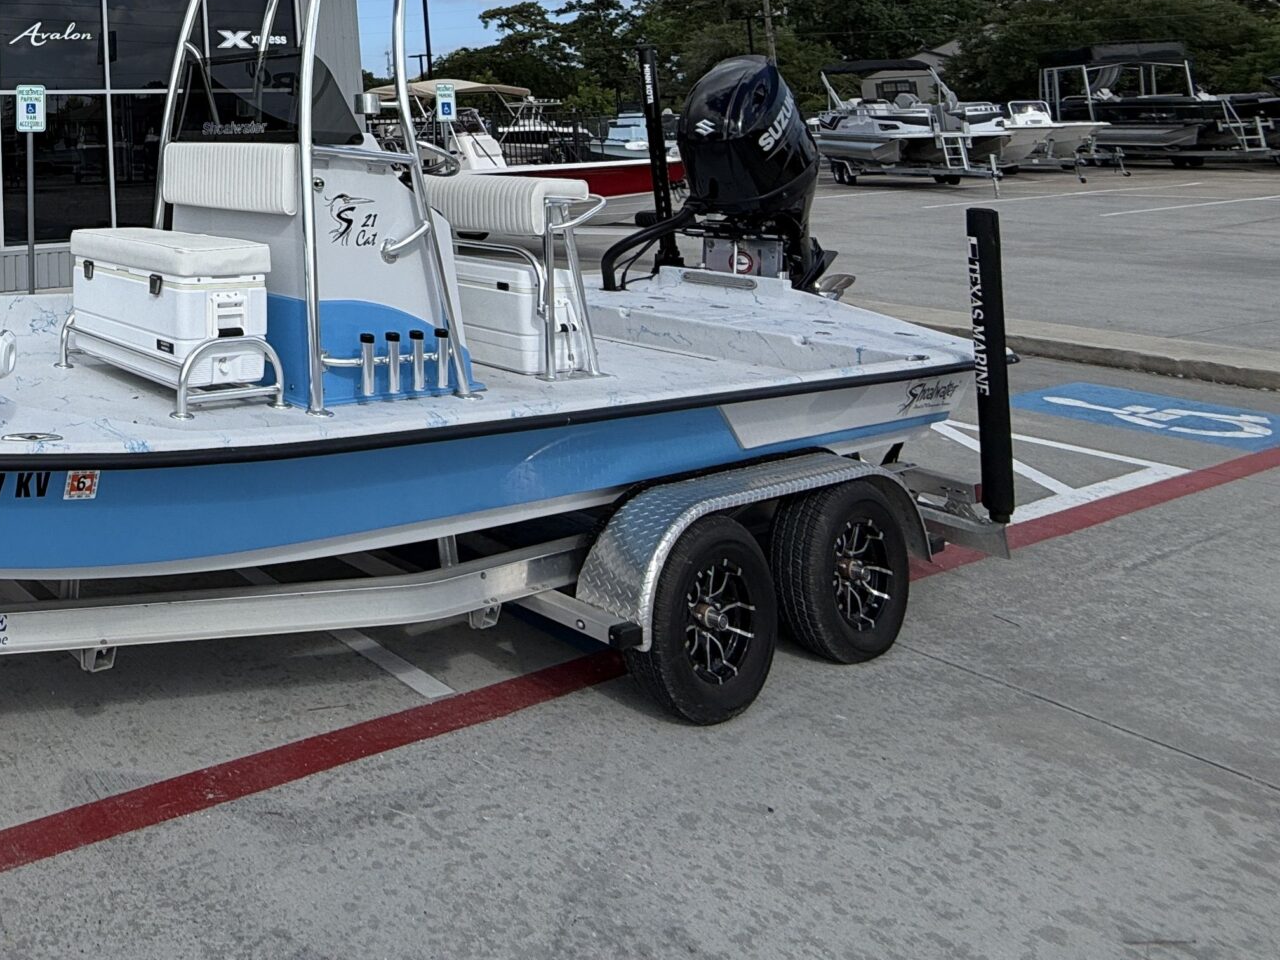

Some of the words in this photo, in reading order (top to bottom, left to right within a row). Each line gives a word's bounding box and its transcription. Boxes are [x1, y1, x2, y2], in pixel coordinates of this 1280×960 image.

[9, 21, 94, 47] Avalon
[251, 35, 288, 46] xess
[202, 121, 268, 135] Shoalwater
[361, 213, 378, 228] 21
[355, 229, 378, 247] Cat
[969, 259, 985, 321] TEXAS
[972, 325, 990, 396] MARINE
[15, 471, 52, 498] KV
